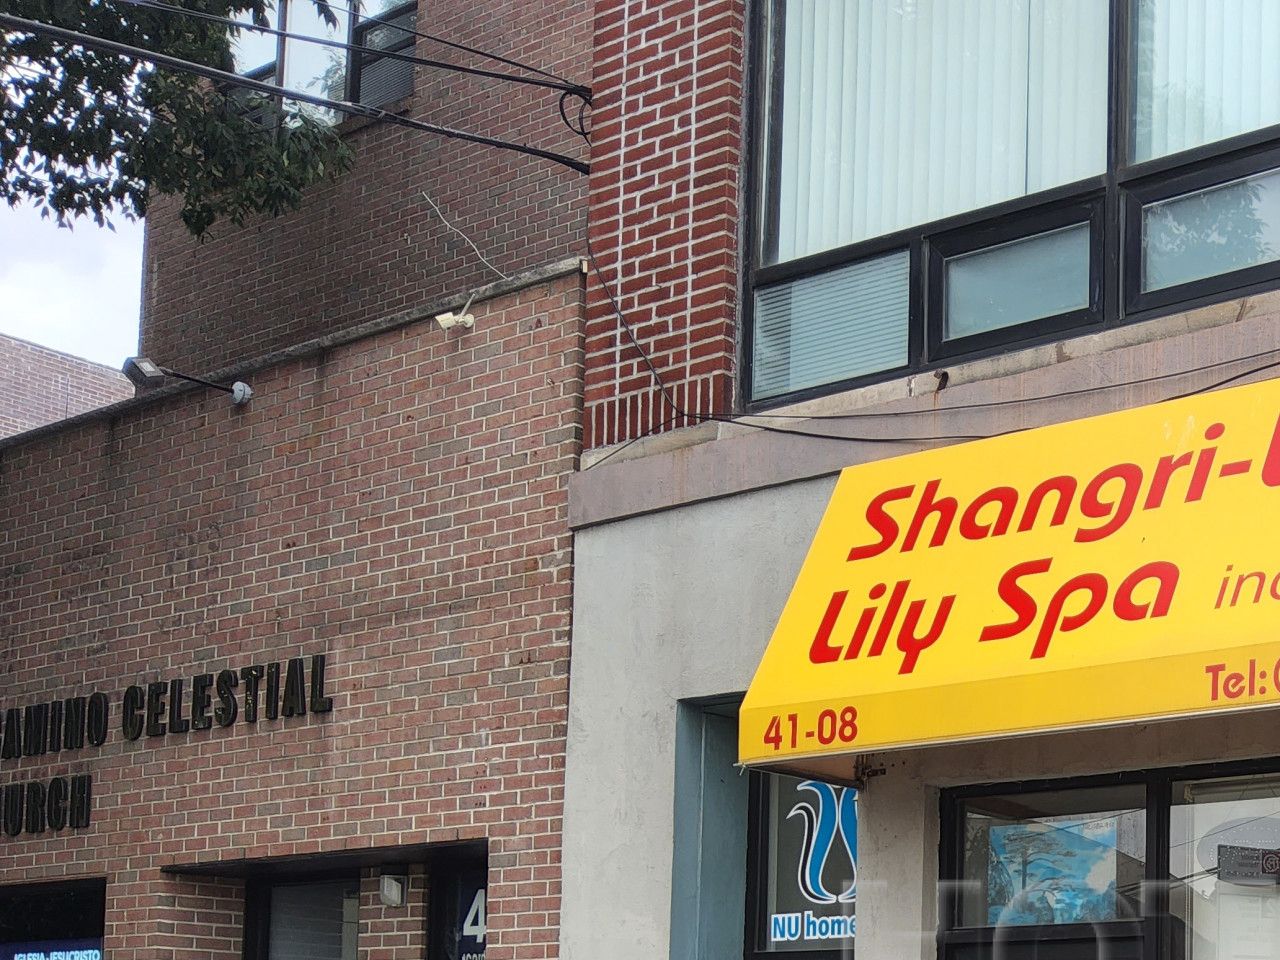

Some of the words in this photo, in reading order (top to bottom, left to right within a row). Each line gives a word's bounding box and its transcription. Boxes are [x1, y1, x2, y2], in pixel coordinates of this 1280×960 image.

[808, 579, 957, 674] Lily
[978, 557, 1181, 660] Spa
[121, 654, 334, 741] CELESTIAL
[763, 708, 860, 750] 41-08
[771, 913, 801, 942] NU
